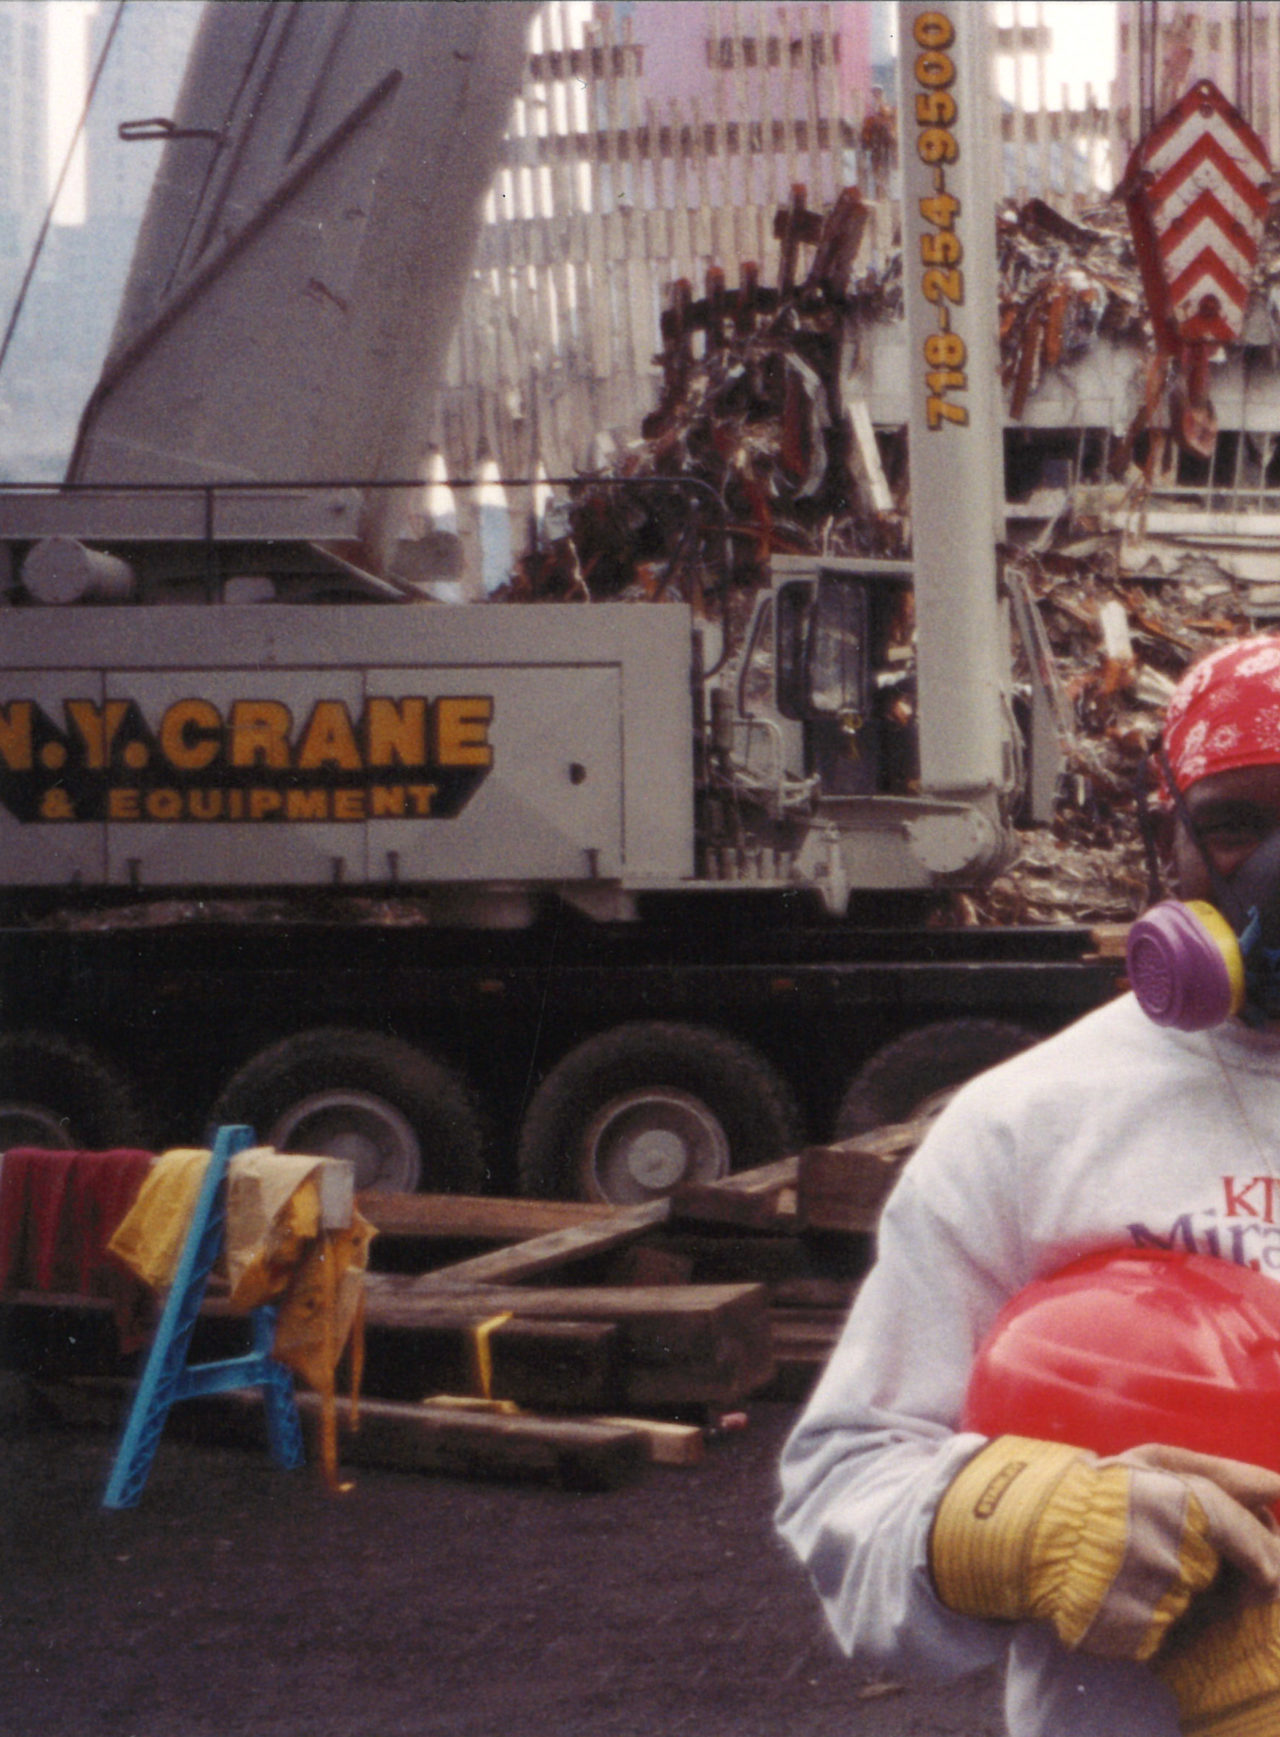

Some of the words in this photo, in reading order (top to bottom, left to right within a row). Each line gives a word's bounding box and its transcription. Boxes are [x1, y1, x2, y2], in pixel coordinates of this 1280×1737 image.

[913, 11, 968, 430] 718-254-9500
[40, 787, 74, 819] &
[107, 785, 439, 819] EQUIPMENT
